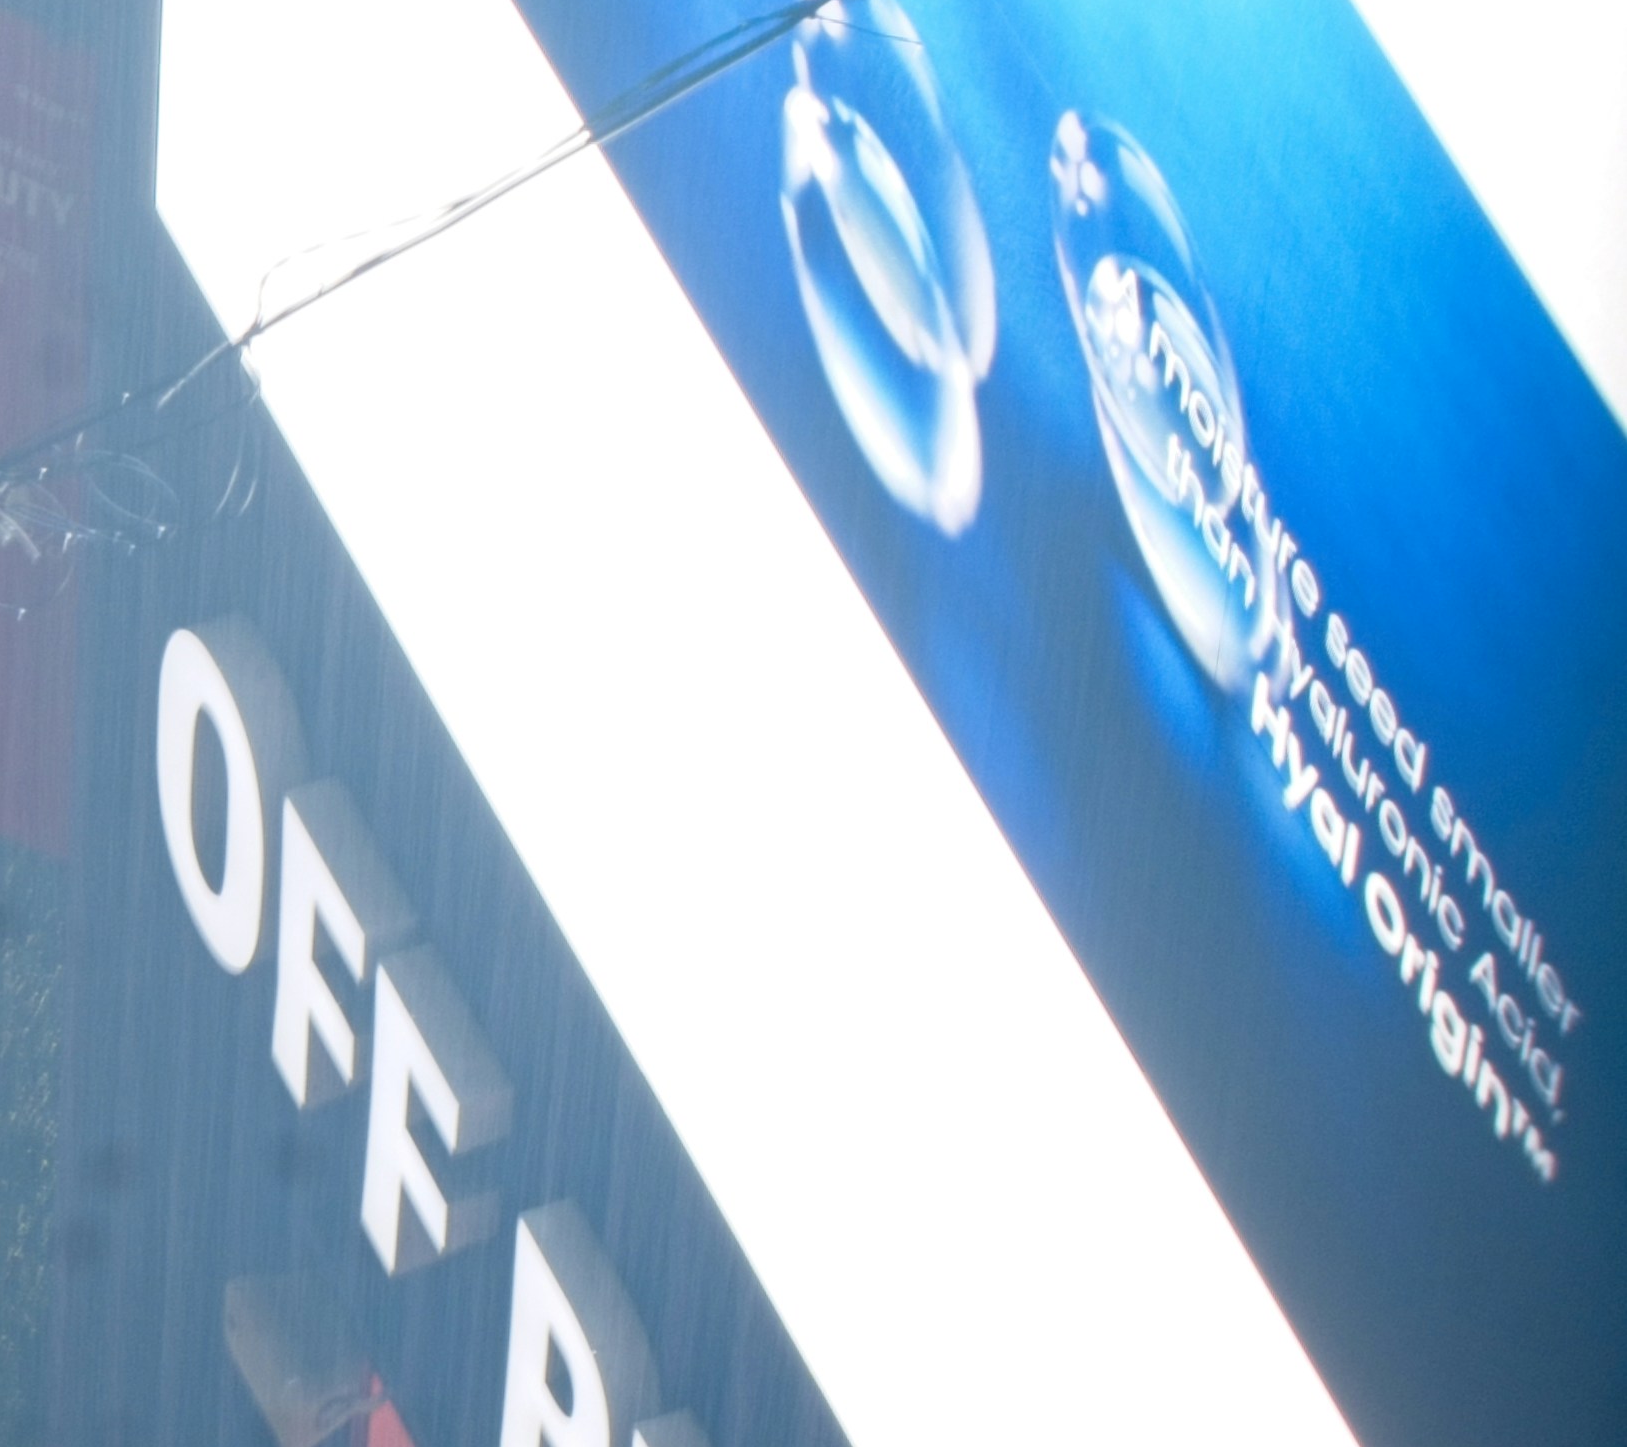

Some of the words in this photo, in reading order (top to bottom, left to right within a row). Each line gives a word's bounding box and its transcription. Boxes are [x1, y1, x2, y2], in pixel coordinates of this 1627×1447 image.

[154, 624, 463, 1280] OFF
[1148, 320, 1322, 615] moisture
[1326, 611, 1427, 793] seed
[1430, 785, 1584, 1036] smaller
[1165, 433, 1257, 608] than
[1261, 602, 1465, 951] Hyaluronic
[1251, 669, 1360, 888] Hyal
